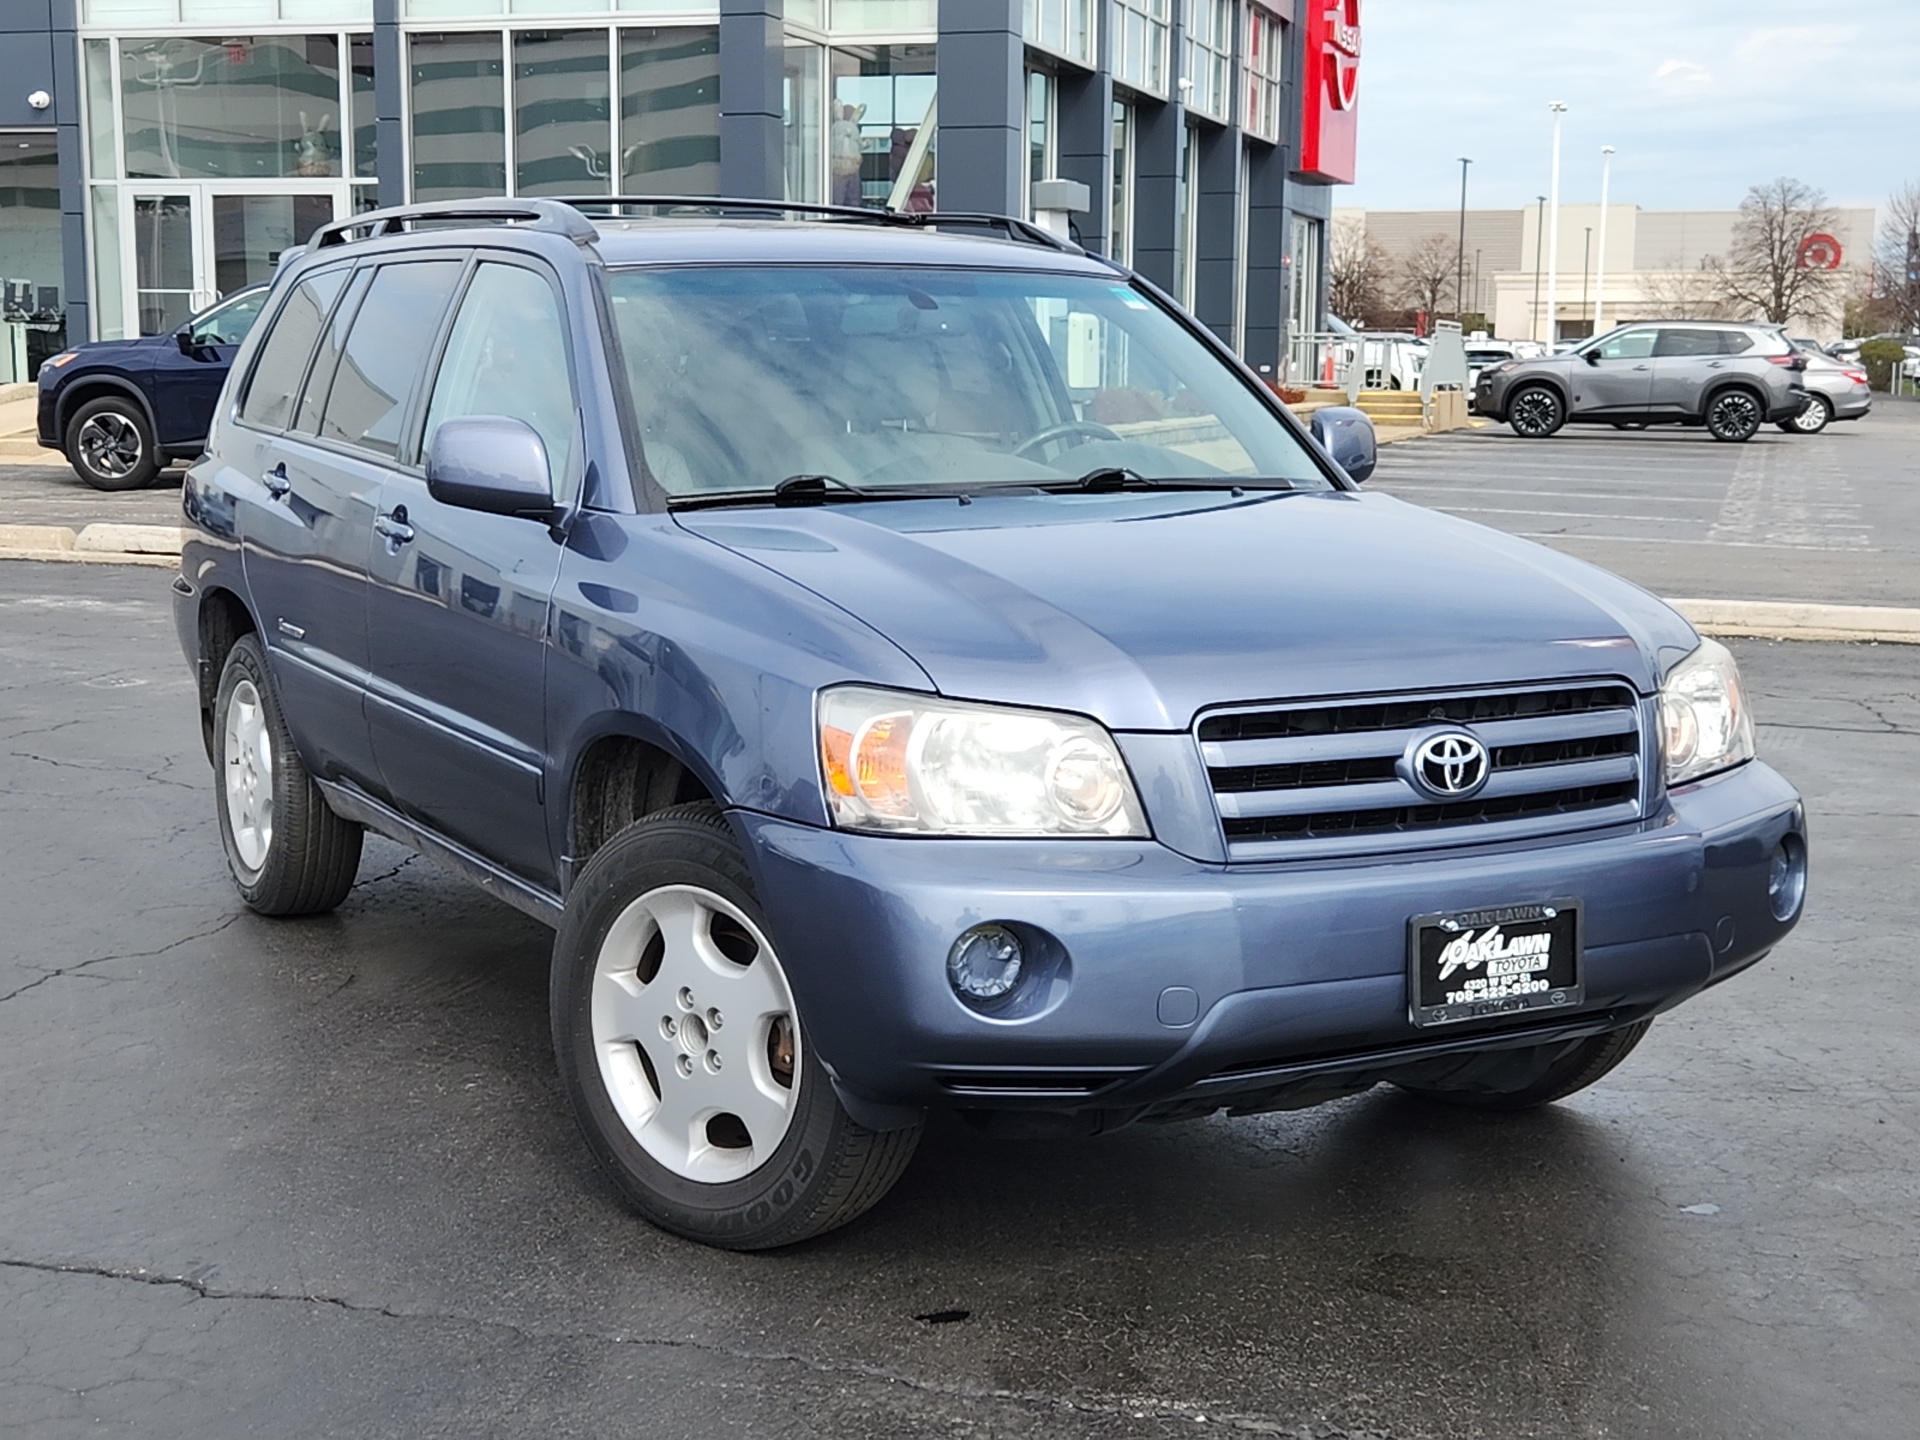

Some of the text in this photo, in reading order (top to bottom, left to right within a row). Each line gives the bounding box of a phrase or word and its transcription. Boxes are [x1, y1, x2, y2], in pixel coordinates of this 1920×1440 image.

[1459, 906, 1541, 925] OAK LAWN
[1495, 956, 1541, 972] TOYOTA
[1445, 979, 1550, 1004] 708-423-5200
[1463, 978, 1488, 990] 4320
[1489, 976, 1499, 987] W
